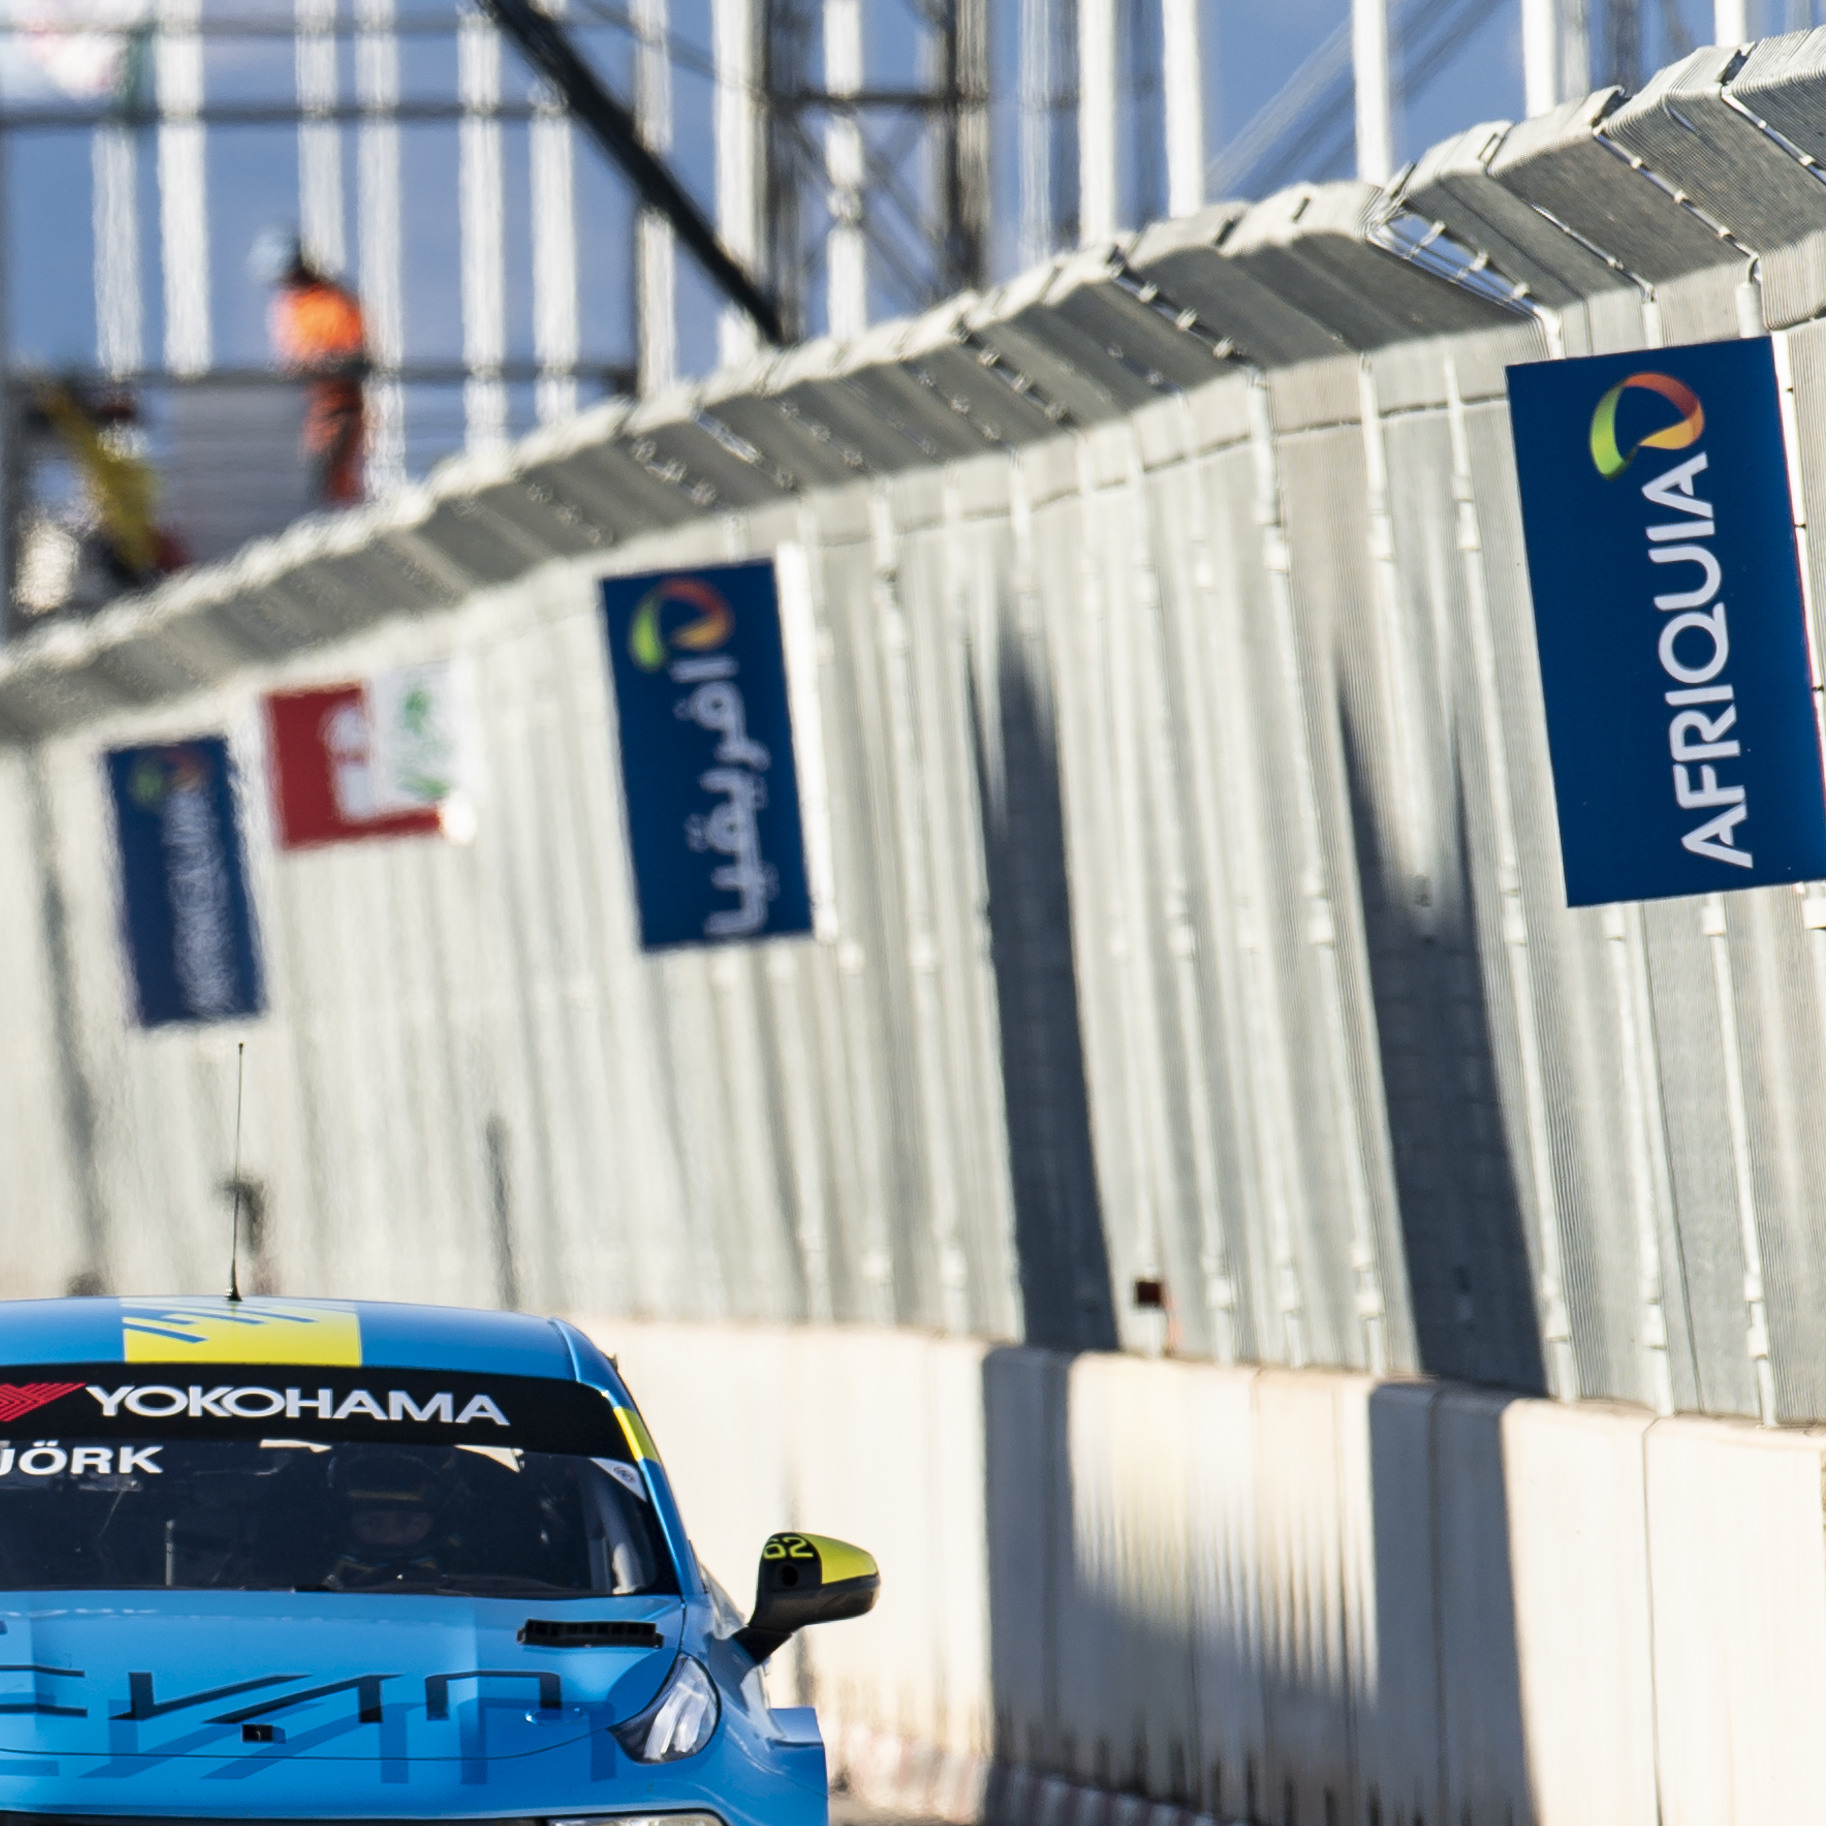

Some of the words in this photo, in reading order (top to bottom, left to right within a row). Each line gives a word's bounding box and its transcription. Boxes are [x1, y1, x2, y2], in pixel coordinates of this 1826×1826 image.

[1642, 451, 1754, 869] AFRIQUIA
[85, 1384, 510, 1425] YOKOHAMA
[763, 1536, 814, 1560] 62
